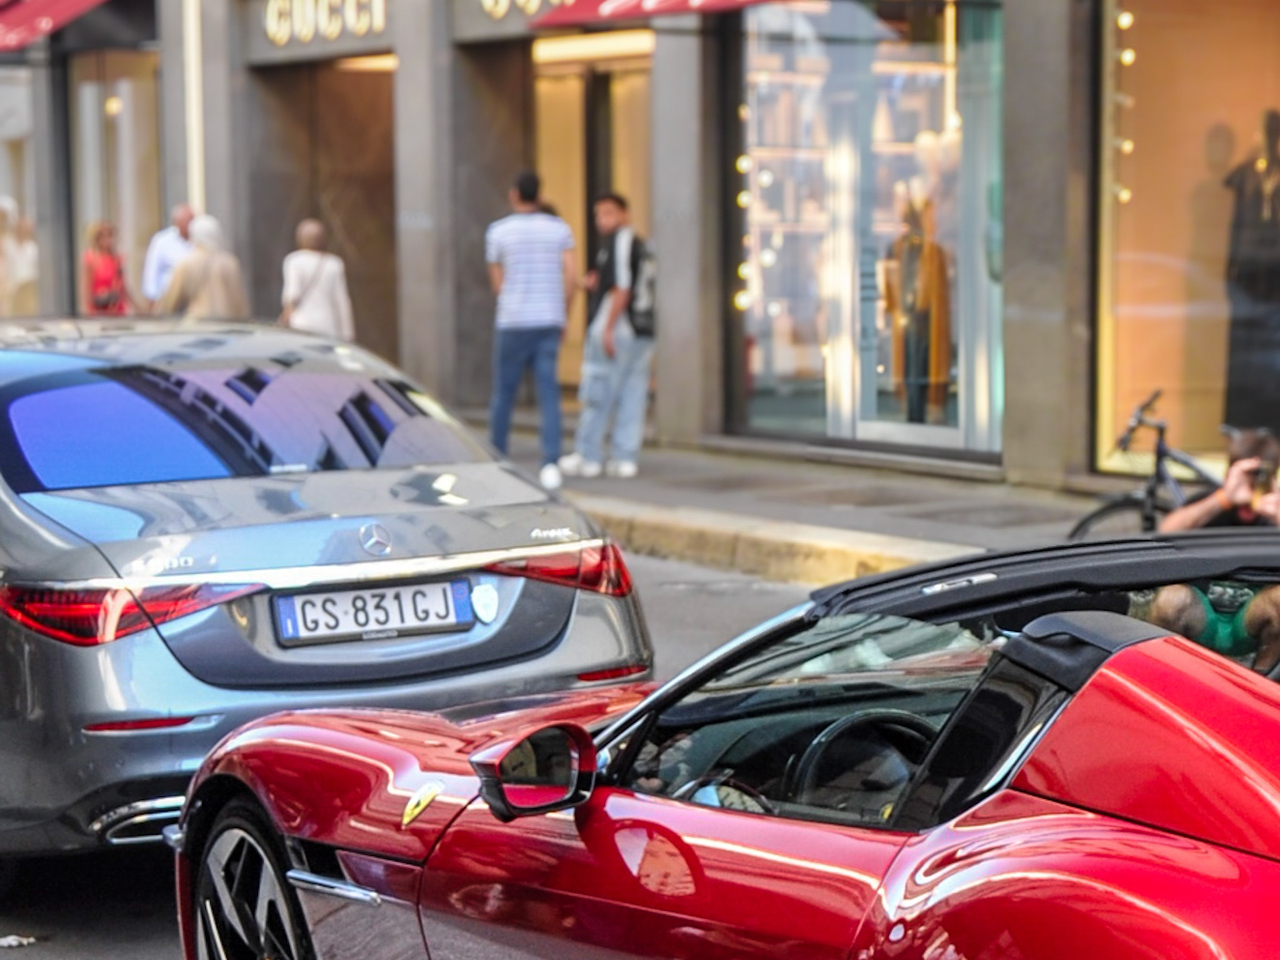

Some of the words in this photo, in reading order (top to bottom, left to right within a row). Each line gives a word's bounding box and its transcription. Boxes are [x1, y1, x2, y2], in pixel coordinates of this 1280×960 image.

[265, 0, 385, 45] GUCCI
[301, 597, 339, 632] GS
[351, 587, 450, 628] 831GJ
